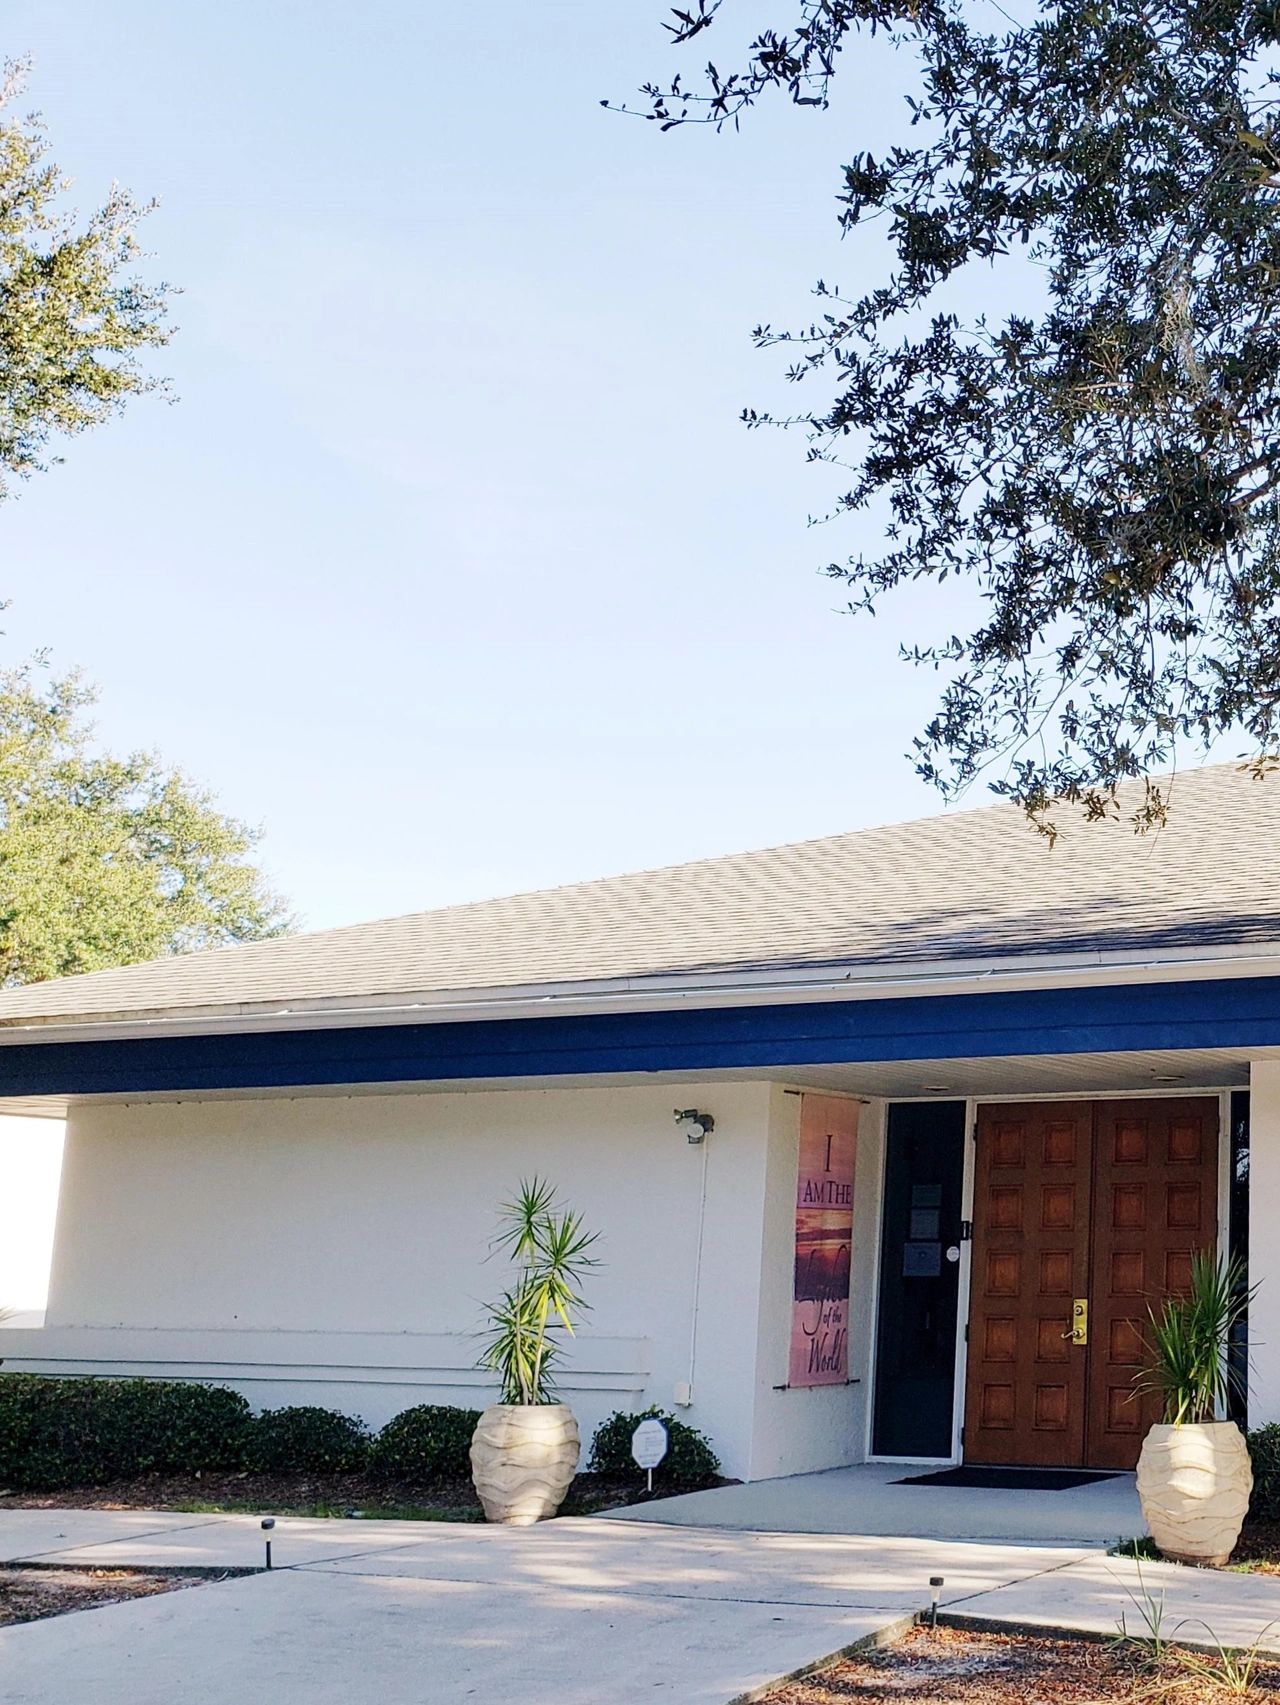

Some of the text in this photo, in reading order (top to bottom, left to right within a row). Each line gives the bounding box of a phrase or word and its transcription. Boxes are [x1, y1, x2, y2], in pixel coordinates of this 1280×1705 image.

[823, 1134, 833, 1173] I
[802, 1179, 851, 1204] AM THE
[822, 1304, 843, 1328] of the
[808, 1328, 846, 1374] World
